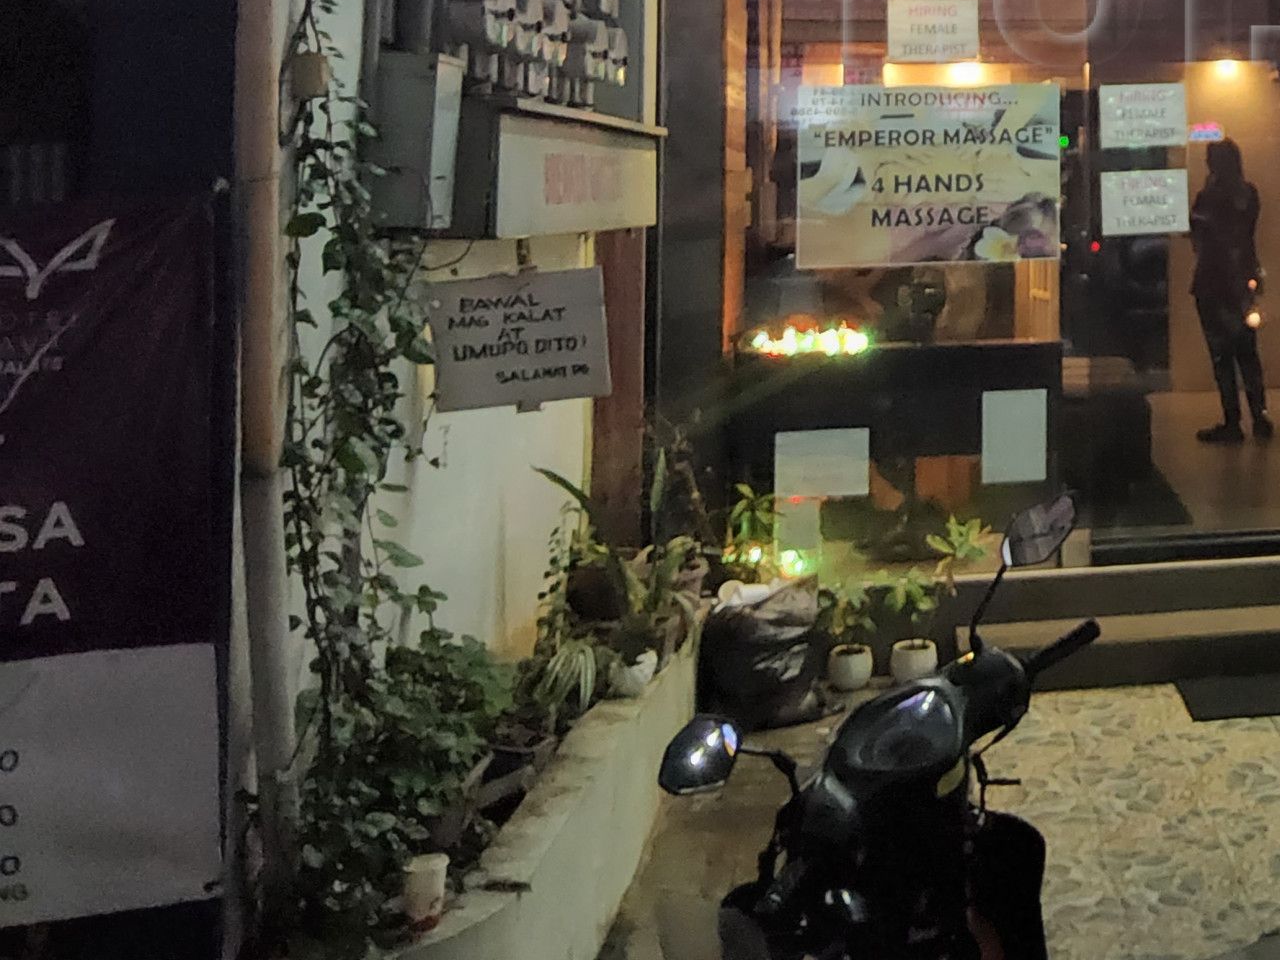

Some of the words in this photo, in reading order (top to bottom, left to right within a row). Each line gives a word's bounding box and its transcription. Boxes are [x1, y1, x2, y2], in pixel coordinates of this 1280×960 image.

[907, 5, 957, 17] HIRING
[910, 23, 958, 35] FEMALE
[902, 43, 966, 56] THERAPIST
[870, 176, 884, 194] 4
[893, 173, 985, 194] HANDS
[870, 206, 989, 228] MASSAGE
[459, 293, 541, 314] BAWAL
[448, 315, 490, 331] MAG
[502, 306, 566, 325] KALAT
[498, 327, 526, 341] AT
[452, 340, 529, 362] UMUPO
